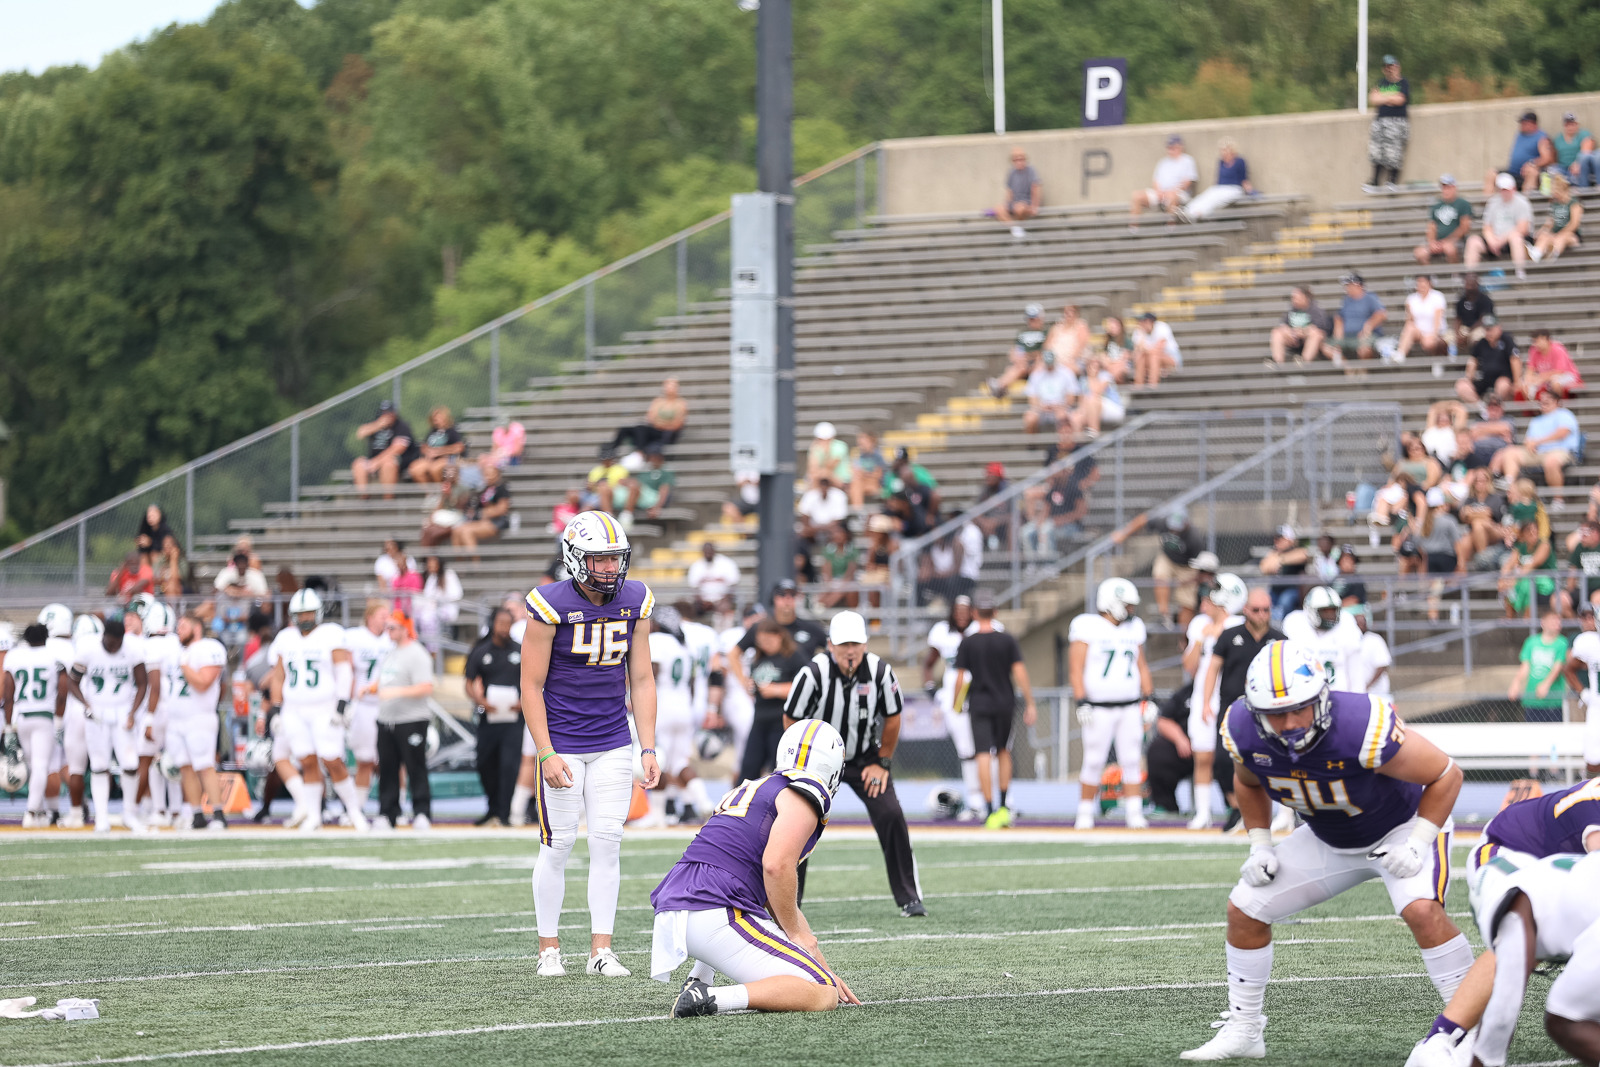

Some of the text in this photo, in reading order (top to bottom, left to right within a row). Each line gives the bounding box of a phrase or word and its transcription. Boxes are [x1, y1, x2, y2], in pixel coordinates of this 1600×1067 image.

[1085, 66, 1123, 121] P
[1082, 150, 1112, 198] P
[571, 620, 628, 666] 46
[15, 667, 48, 700] 25
[787, 747, 795, 755] 90
[1290, 769, 1308, 778] WCU
[1266, 776, 1364, 817] 34
